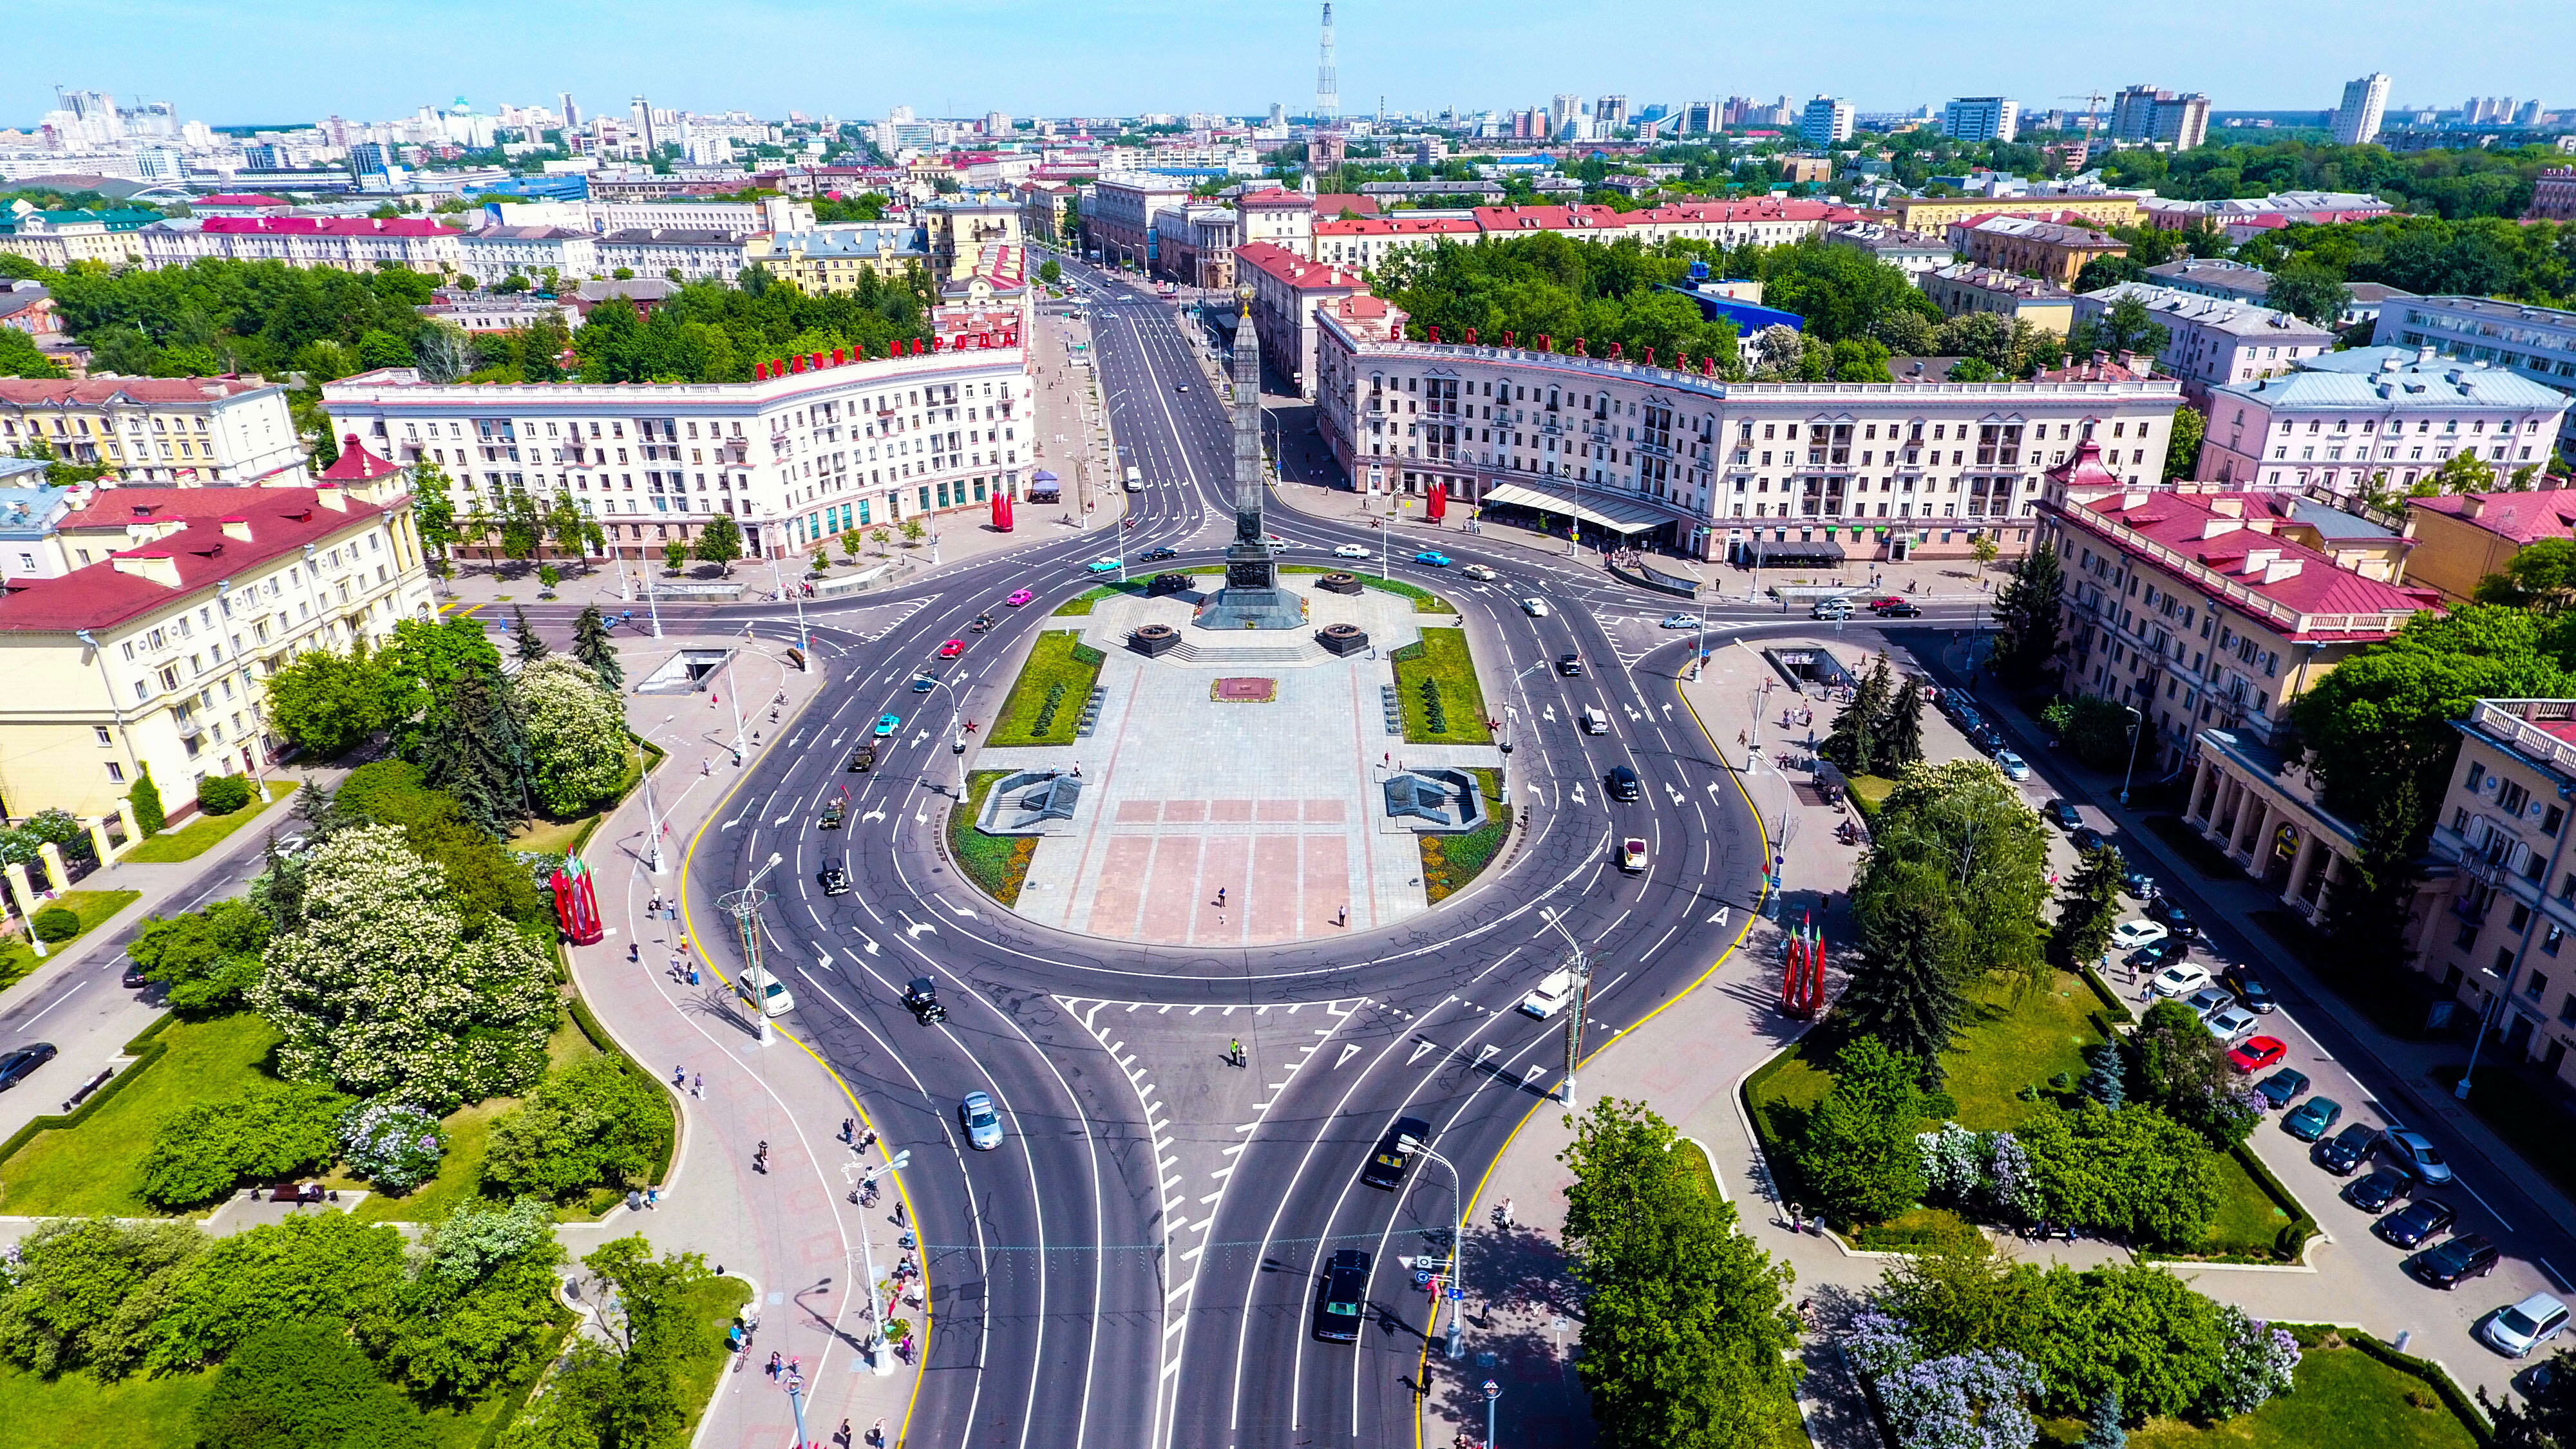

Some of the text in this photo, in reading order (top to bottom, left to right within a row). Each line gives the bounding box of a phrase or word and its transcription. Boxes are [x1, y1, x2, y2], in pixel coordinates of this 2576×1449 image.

[755, 331, 1014, 381] ПОДВИГ НАРОДА
[1391, 325, 1713, 375] БЕССМЕРТЕН
